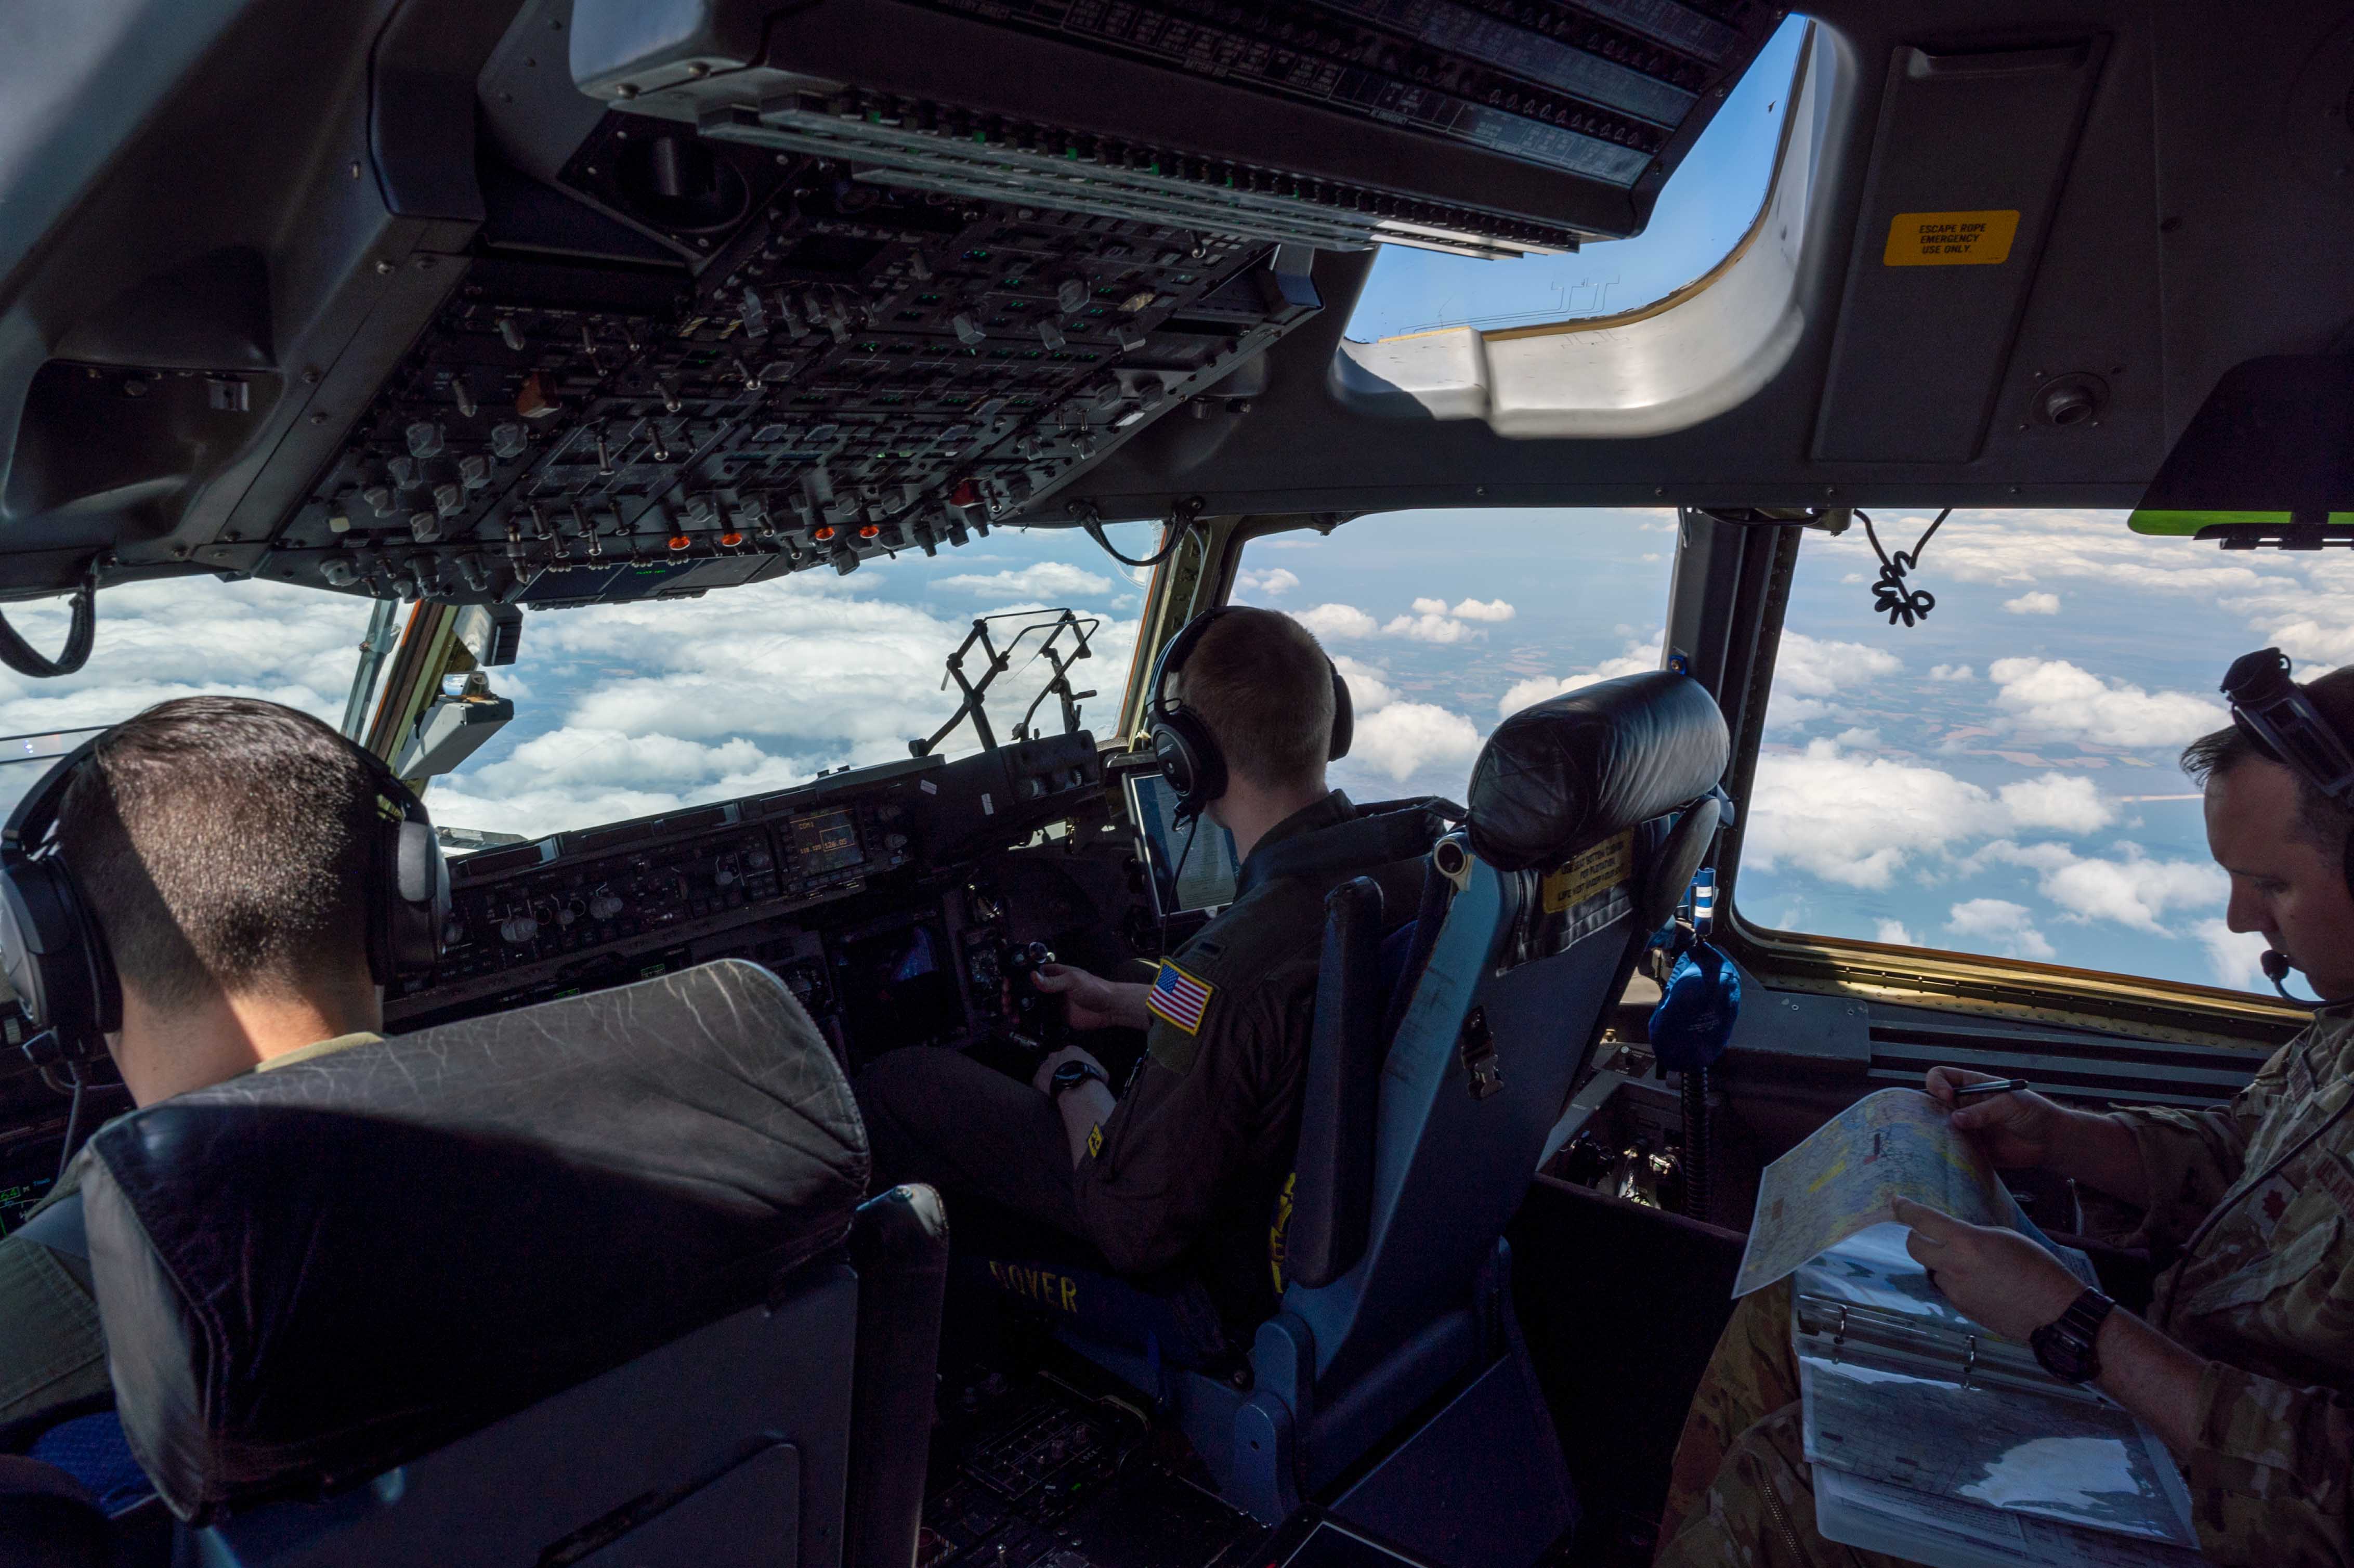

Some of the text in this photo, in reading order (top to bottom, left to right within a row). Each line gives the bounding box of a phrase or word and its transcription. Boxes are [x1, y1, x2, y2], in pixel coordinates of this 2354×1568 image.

[1919, 223, 1987, 233] ESCAPE ROPE
[1920, 234, 1980, 244] EMERGENCY
[1922, 245, 1941, 254] USE
